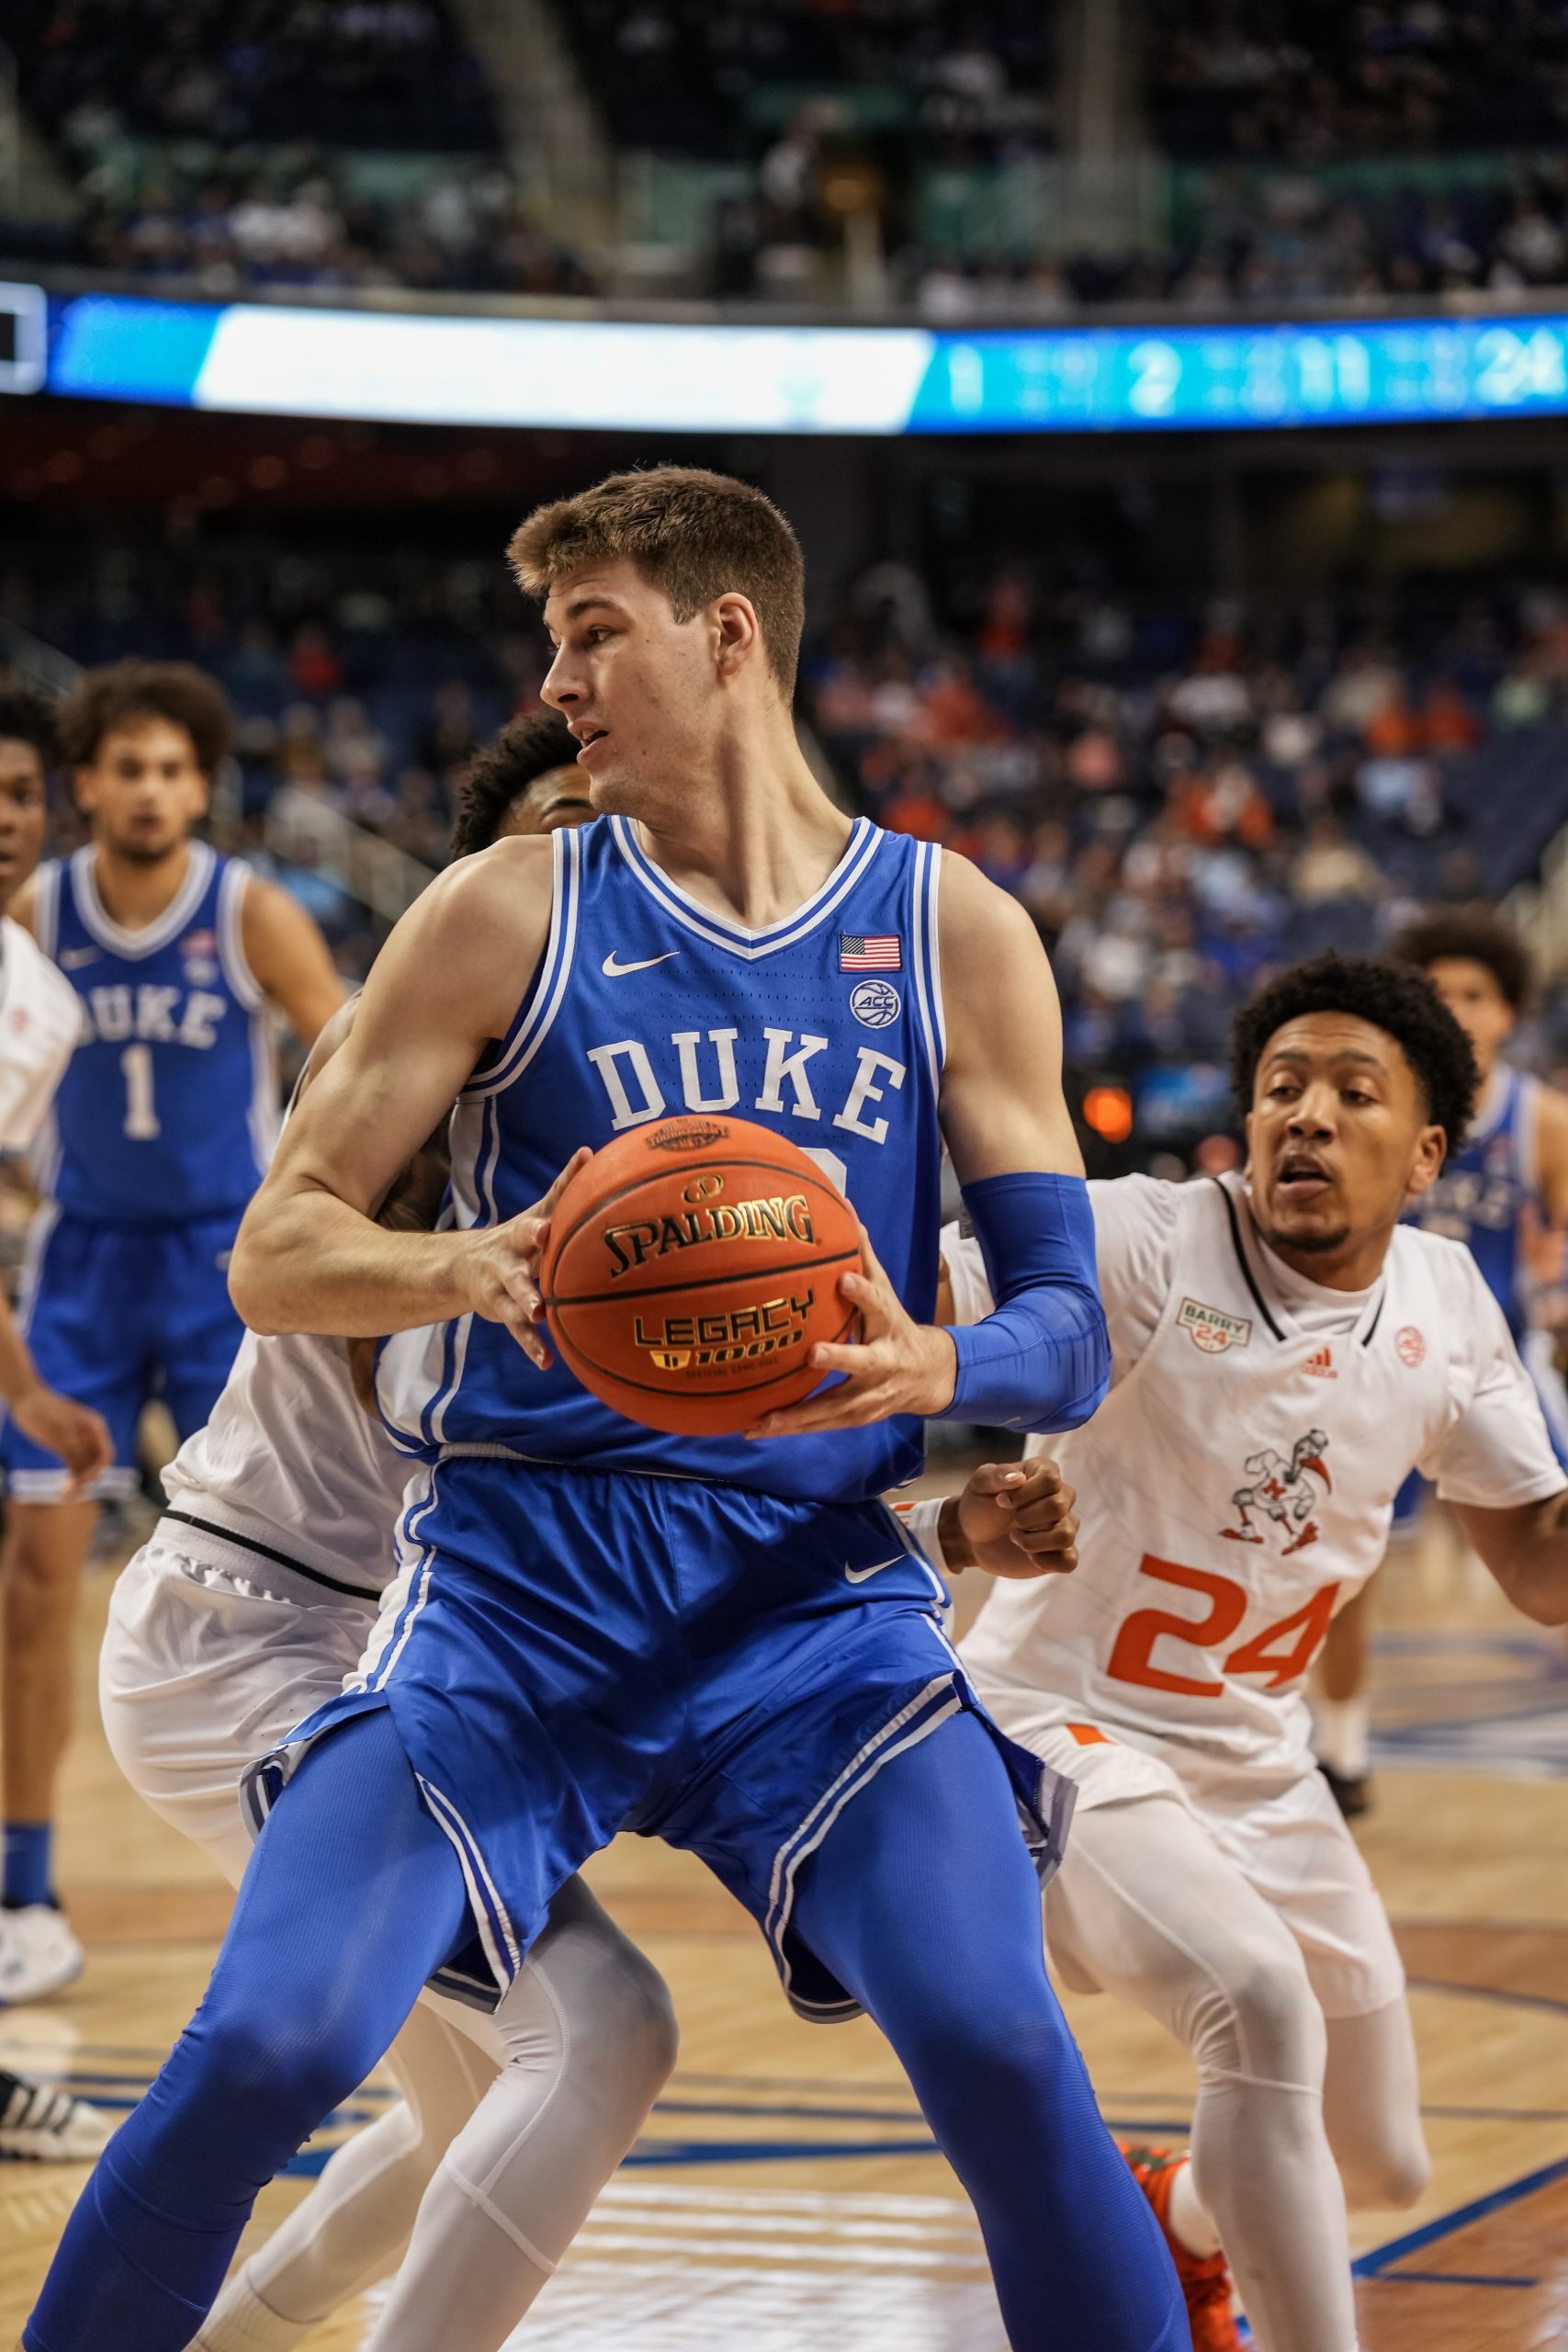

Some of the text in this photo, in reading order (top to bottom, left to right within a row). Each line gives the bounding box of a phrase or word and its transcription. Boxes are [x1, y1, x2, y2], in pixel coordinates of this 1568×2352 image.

[1126, 340, 1182, 417] 2
[858, 995, 896, 1009] ACC
[120, 1044, 161, 1140] 1
[586, 1026, 907, 1146] DUKE
[603, 1193, 816, 1279] SPALDING
[633, 1288, 816, 1347] LEGACY
[694, 1329, 805, 1367] 1000
[1184, 1303, 1246, 1334] BARRY
[1195, 1321, 1229, 1346] 24
[1106, 1553, 1340, 1697] 24
